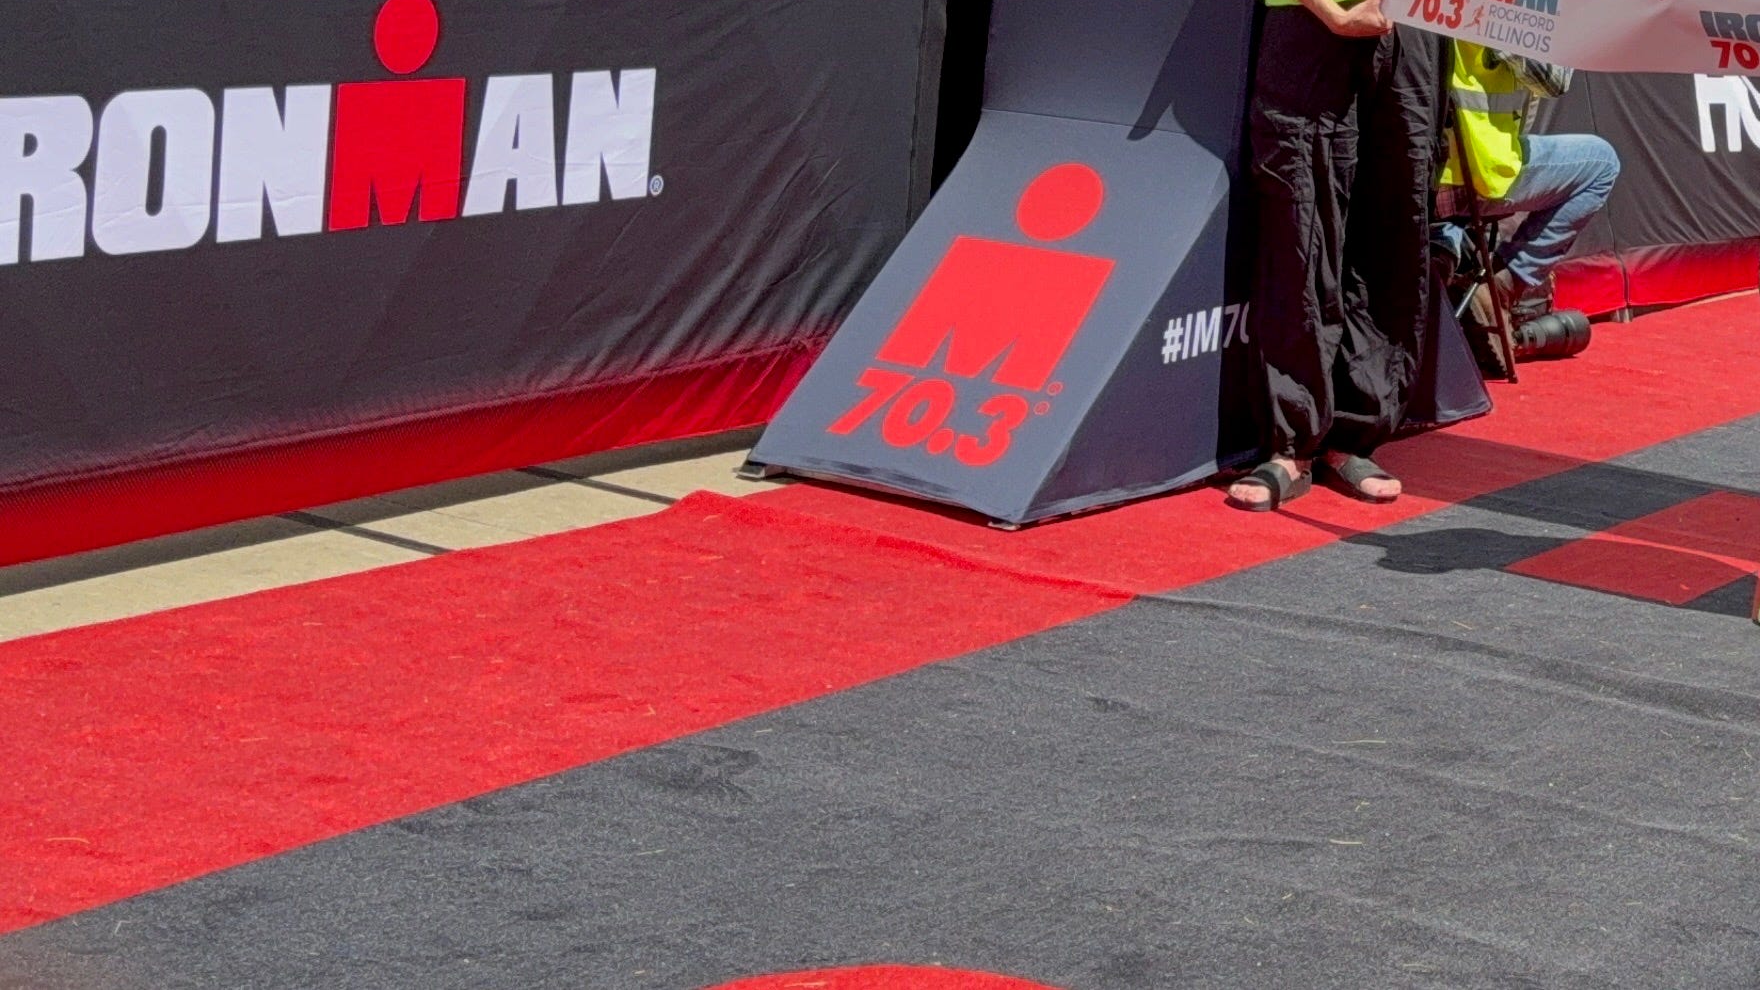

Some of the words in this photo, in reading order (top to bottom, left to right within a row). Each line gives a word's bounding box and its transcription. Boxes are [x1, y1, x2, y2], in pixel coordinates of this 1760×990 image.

[1488, 4, 1556, 32] ROCKFORD
[1484, 21, 1552, 53] ILLINOIS
[827, 367, 1029, 467] 70.3
